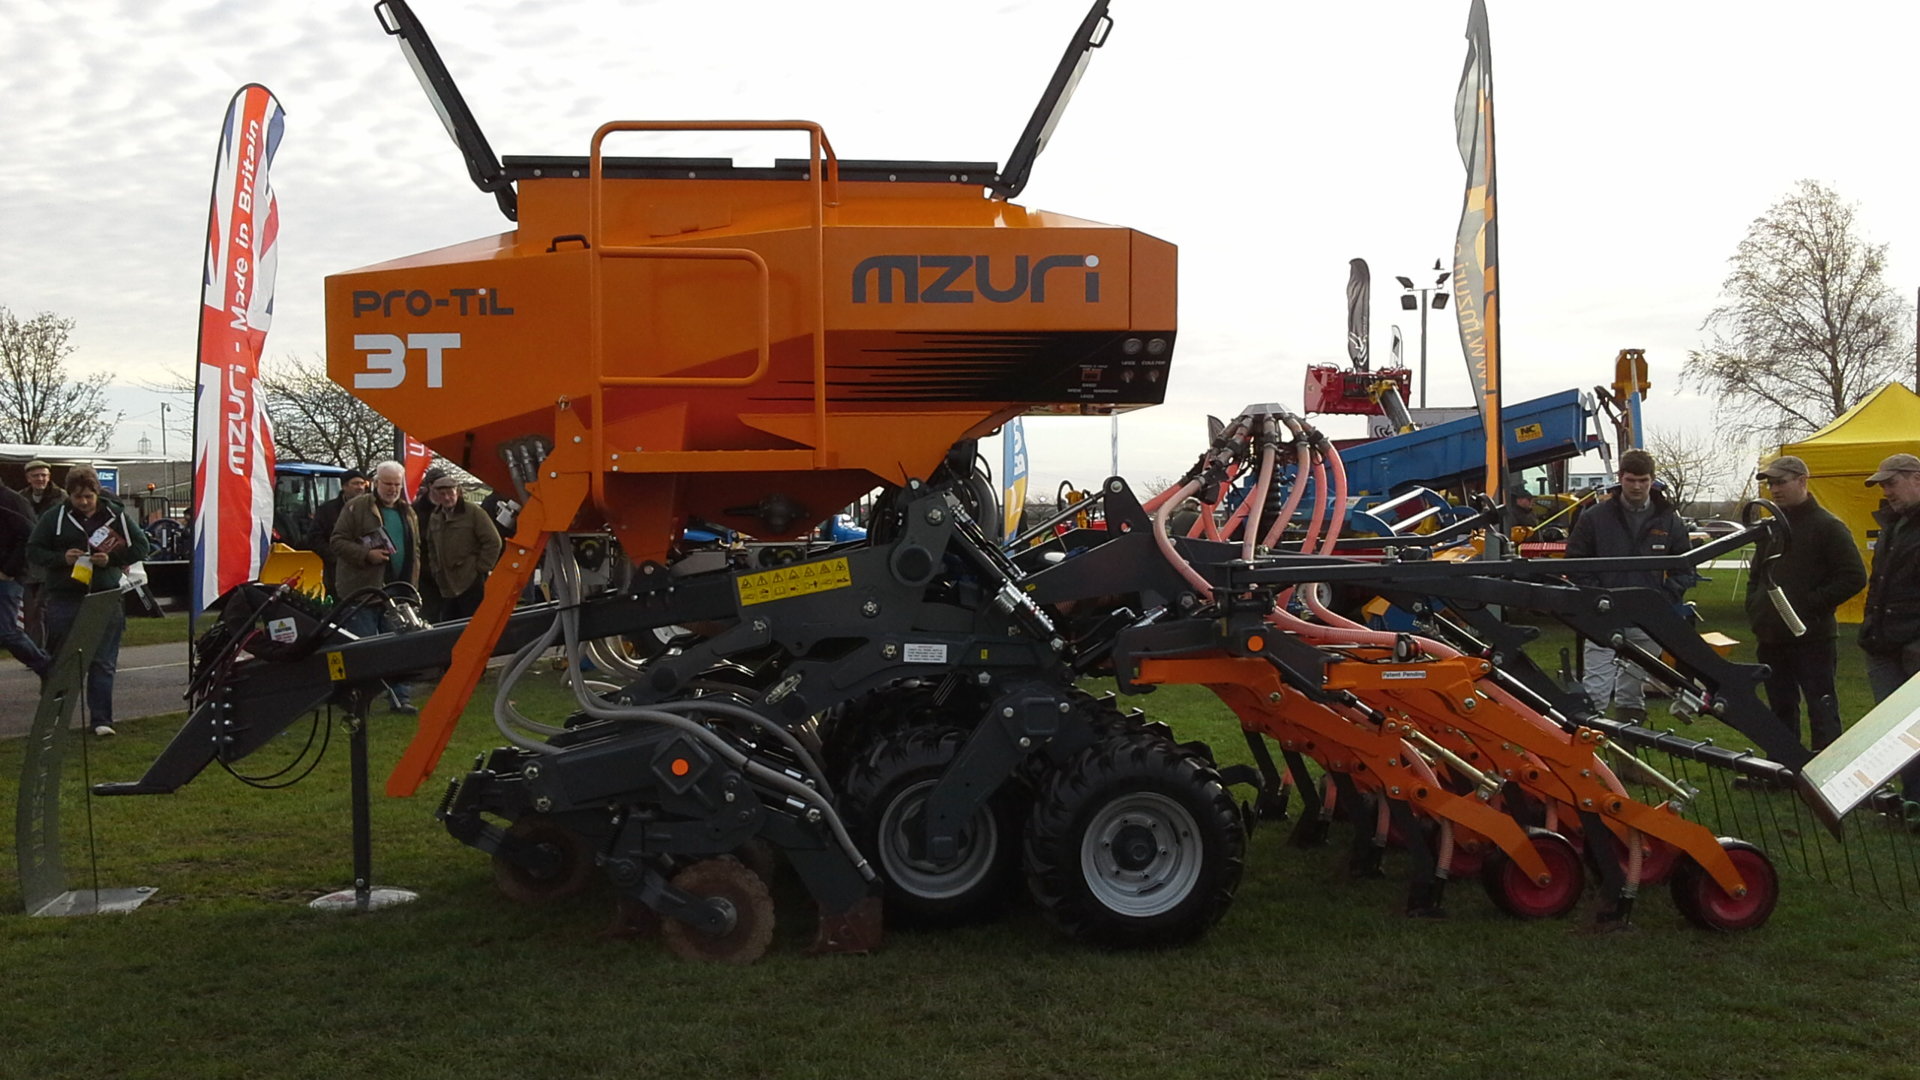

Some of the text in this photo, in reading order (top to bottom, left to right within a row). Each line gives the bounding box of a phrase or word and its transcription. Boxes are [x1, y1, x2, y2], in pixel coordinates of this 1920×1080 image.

[238, 119, 259, 214] Britain
[235, 223, 249, 249] in
[230, 258, 248, 332] Made
[354, 333, 461, 389] 3T
